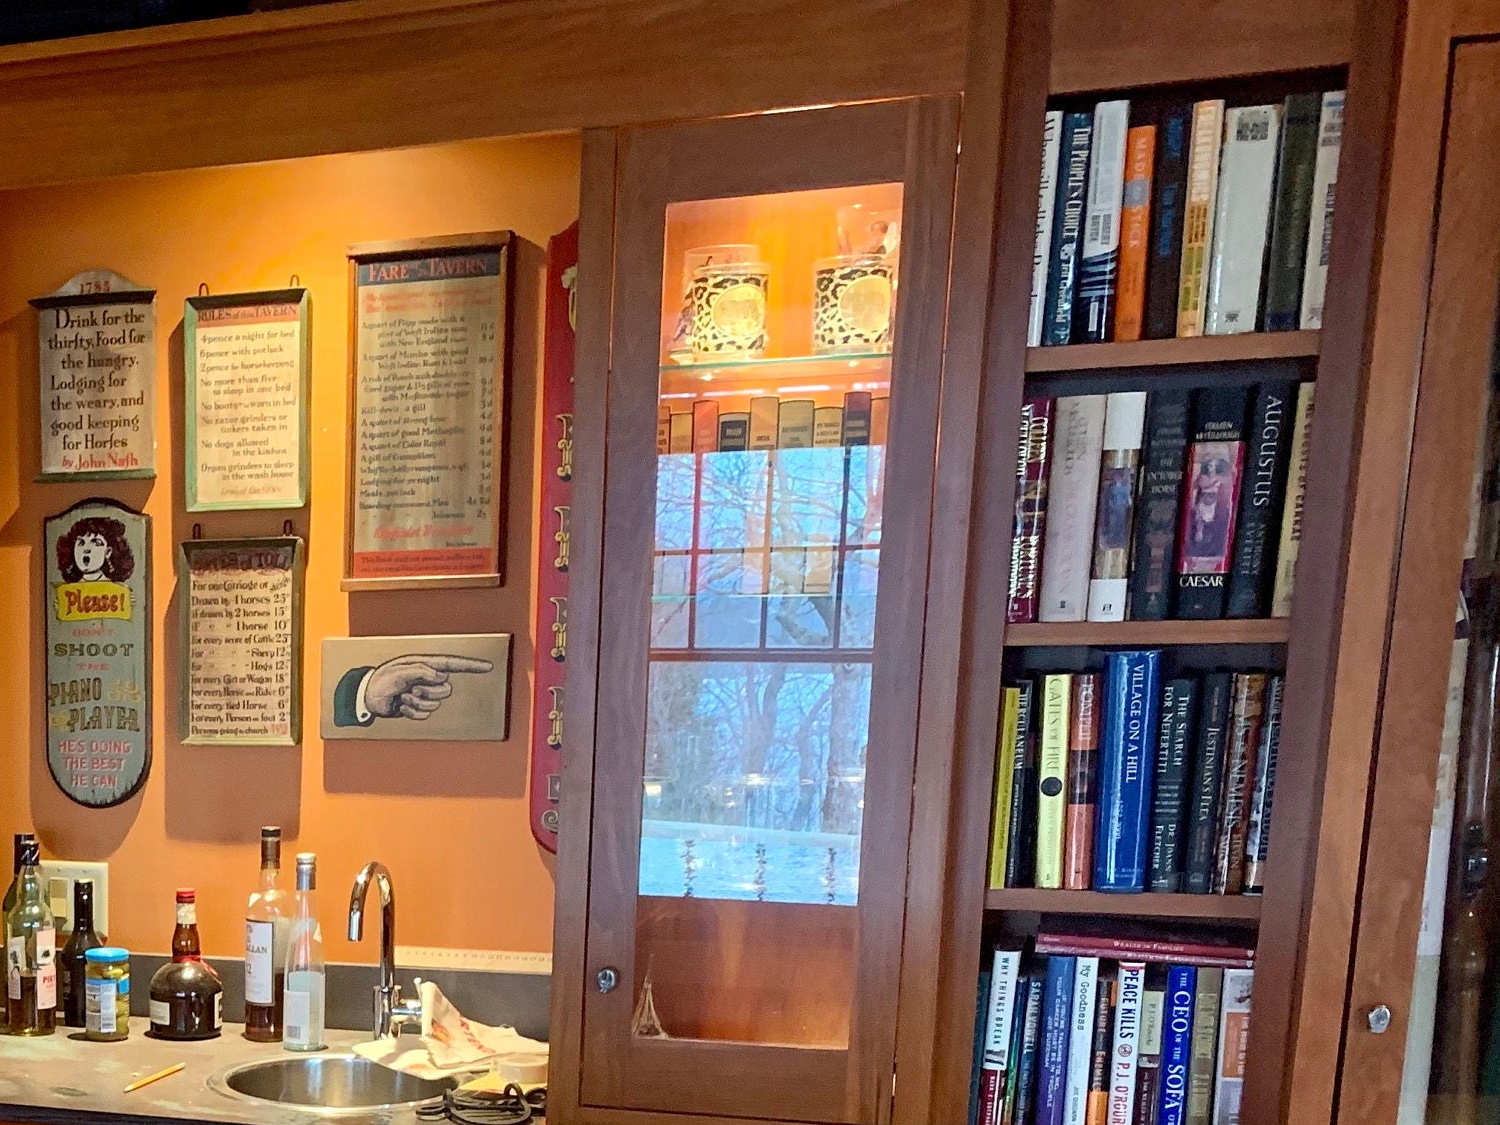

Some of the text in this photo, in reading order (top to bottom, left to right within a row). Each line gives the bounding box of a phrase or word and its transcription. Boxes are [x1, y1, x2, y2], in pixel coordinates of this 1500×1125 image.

[1063, 201, 1082, 239] CHOICE
[369, 256, 488, 281] FARE TAVERN
[55, 307, 145, 329] Drink for the
[199, 304, 297, 322] RULES TAVERN
[96, 328, 126, 347] Food
[128, 328, 146, 344] for
[61, 353, 84, 369] the
[50, 370, 127, 395] Lodging for
[275, 383, 292, 392] bed
[51, 395, 73, 411] the
[120, 390, 145, 407] and
[51, 414, 140, 437] good keeping
[62, 434, 81, 450] for
[1253, 395, 1283, 507] AUGUSTUS
[75, 453, 106, 470] John
[1180, 575, 1225, 588] CAESAR
[65, 588, 126, 616] Please!
[54, 643, 135, 657] SHOOT
[49, 676, 102, 707] PIANO
[67, 705, 140, 733] PLAYER
[1014, 692, 1028, 770] HERCULANEUM
[1046, 678, 1063, 772] GATES FIRE
[1125, 664, 1144, 784] VILLAGE ON A HILL
[1157, 686, 1174, 774] FOR NEFERTITI
[1172, 695, 1189, 767] THE SEARCH
[90, 740, 132, 754] DOING
[63, 757, 126, 772] THE BEST
[71, 775, 118, 790] HE CAN
[1225, 758, 1248, 829] NEMESIS
[1152, 825, 1165, 870] FLETCHER
[1179, 972, 1188, 988] THE
[992, 957, 1010, 1046] WHY THINGS BREAK
[1028, 981, 1042, 1012] SARAH
[1077, 964, 1091, 1031] My Goodness
[1119, 969, 1139, 1039] PEACE KILLS
[1171, 990, 1191, 1038] CEO
[1023, 1016, 1037, 1055] VOWELL
[1115, 1062, 1131, 1082] P.J.
[1164, 1064, 1185, 1110] SOFA
